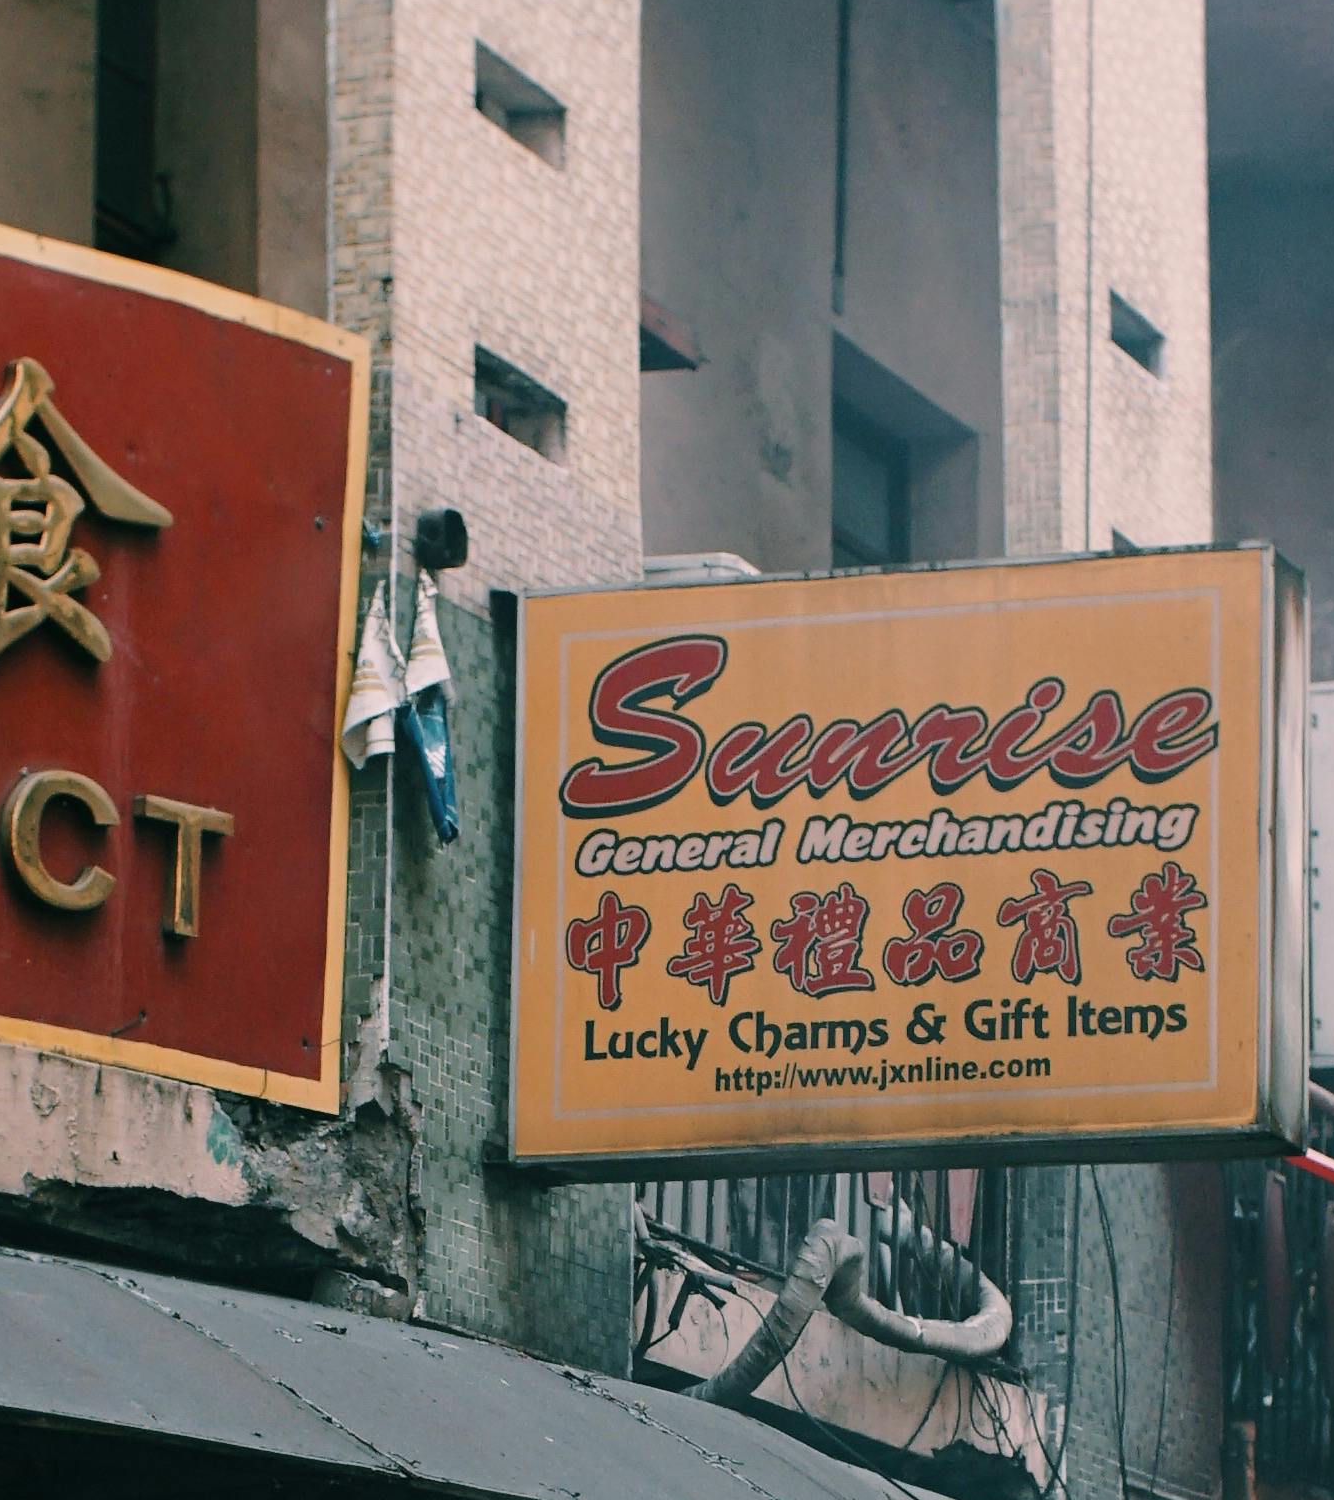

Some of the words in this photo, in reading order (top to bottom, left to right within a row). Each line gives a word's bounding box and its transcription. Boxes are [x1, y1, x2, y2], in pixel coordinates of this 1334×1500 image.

[560, 634, 1219, 819] Sunrise
[575, 817, 787, 878] General
[796, 797, 1201, 867] Merchandising
[565, 861, 1212, 1012] 中華禮品商業
[583, 1017, 708, 1071] Lucky
[728, 1010, 890, 1058] Charms
[906, 1002, 947, 1046] &
[964, 997, 1051, 1041] Gift
[1067, 994, 1189, 1042] Items
[714, 1056, 1052, 1095] http://www.jxnline.com
